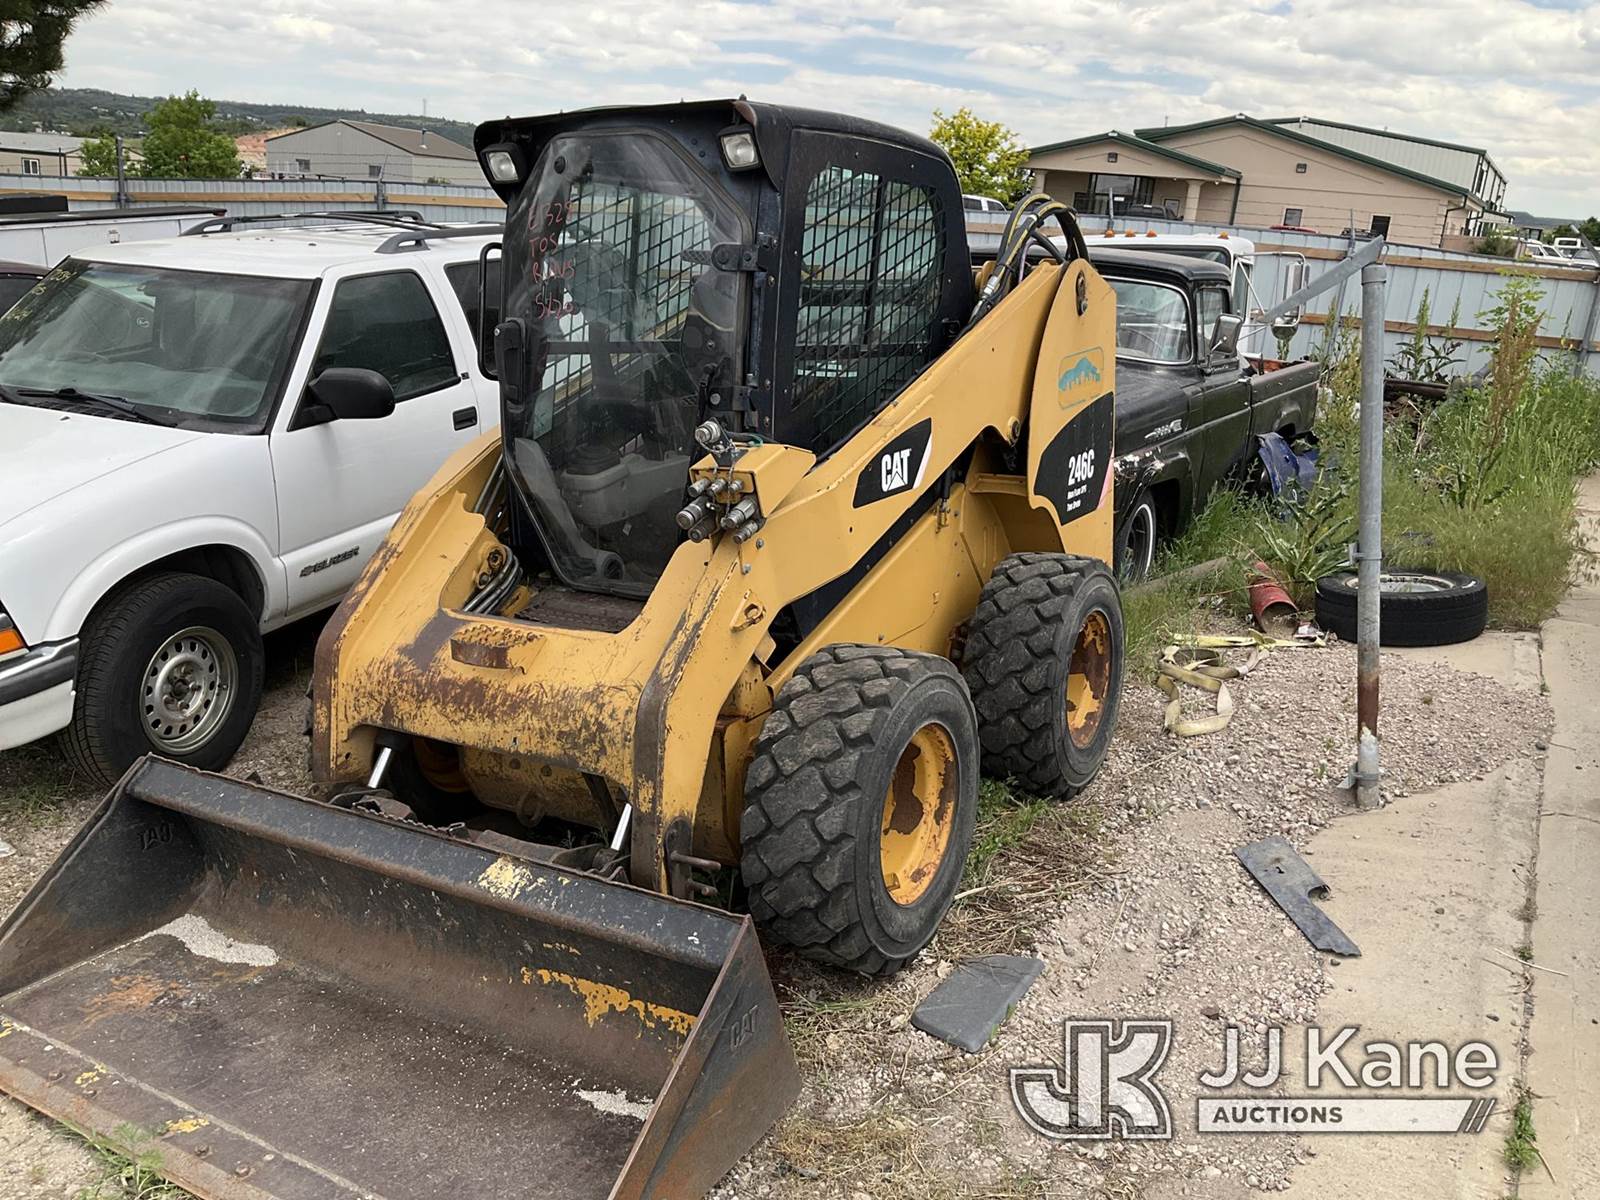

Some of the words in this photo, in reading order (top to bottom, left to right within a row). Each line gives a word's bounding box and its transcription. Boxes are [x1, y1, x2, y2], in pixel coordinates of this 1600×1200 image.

[881, 448, 912, 492] CAT
[1068, 448, 1095, 486] 246C
[731, 1003, 759, 1052] CAT
